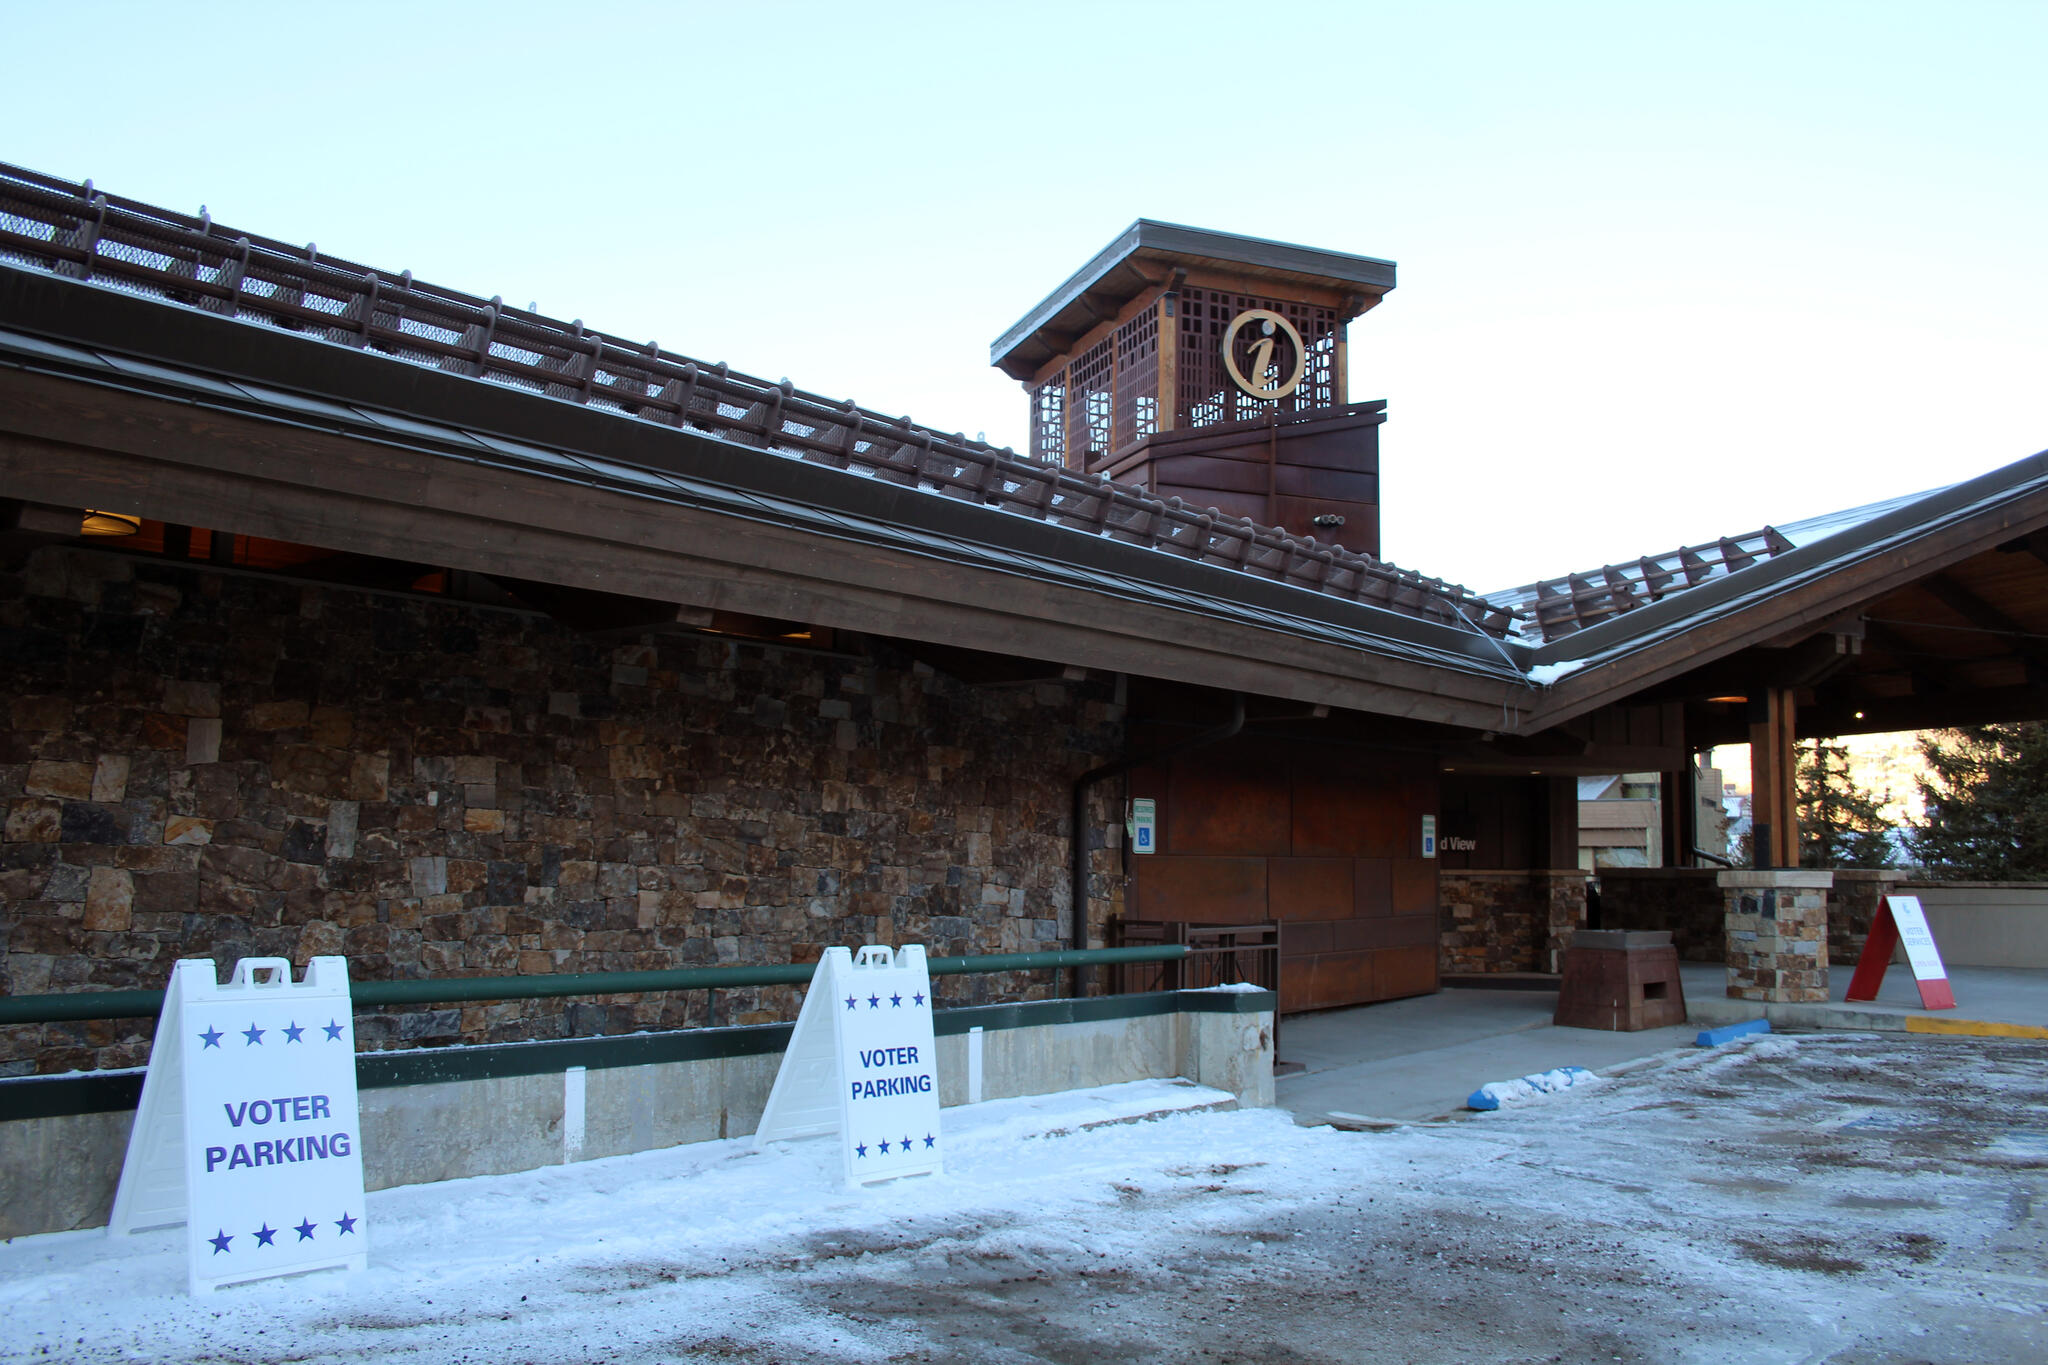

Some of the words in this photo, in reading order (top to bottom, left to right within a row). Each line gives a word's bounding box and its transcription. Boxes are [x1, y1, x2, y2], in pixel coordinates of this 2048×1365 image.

[1449, 836, 1476, 851] View
[859, 1046, 919, 1068] VOTER
[851, 1074, 931, 1100] PARKING
[224, 1094, 331, 1128] VOTER
[205, 1132, 351, 1173] PARKING
